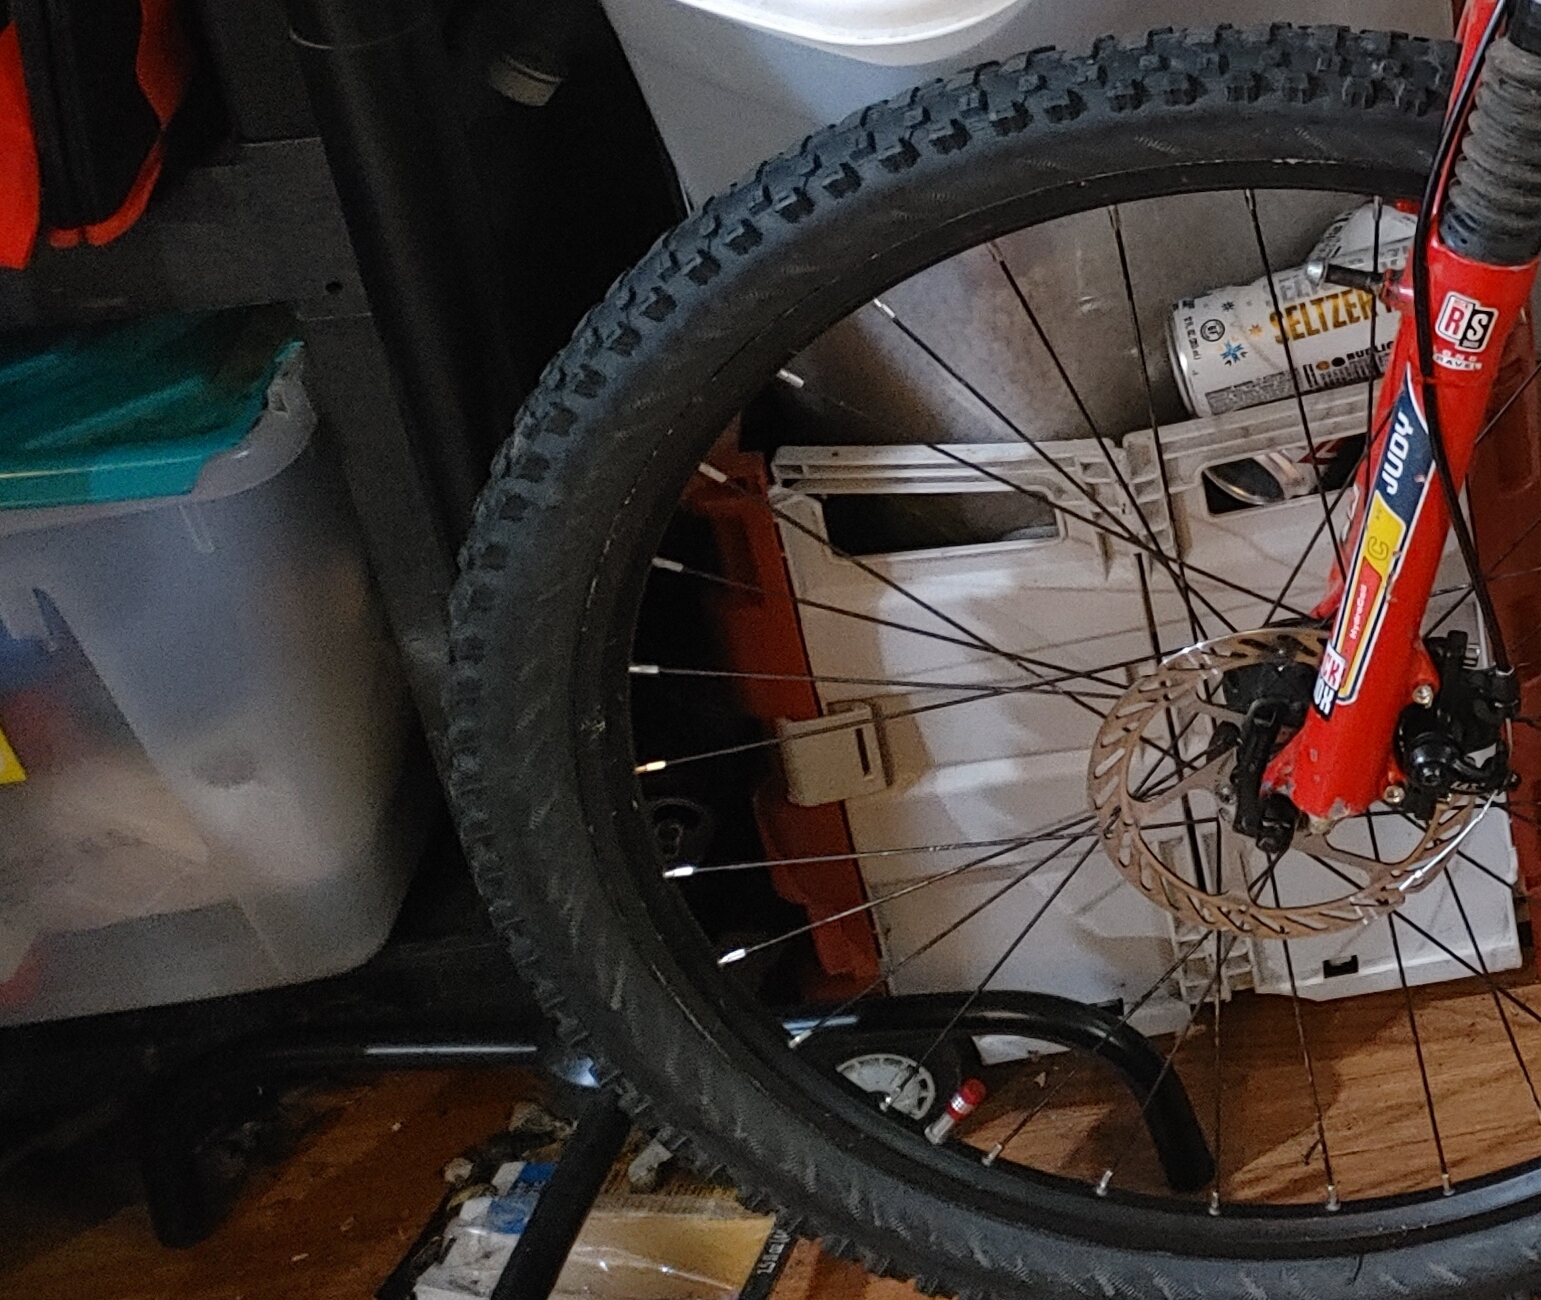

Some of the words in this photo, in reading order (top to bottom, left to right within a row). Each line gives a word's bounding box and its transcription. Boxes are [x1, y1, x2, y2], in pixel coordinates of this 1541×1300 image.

[1269, 289, 1376, 345] SELTZER
[1434, 354, 1481, 370] RAVEL
[1381, 410, 1414, 495] JUDY
[1320, 651, 1344, 687] CK
[1313, 683, 1336, 716] OX
